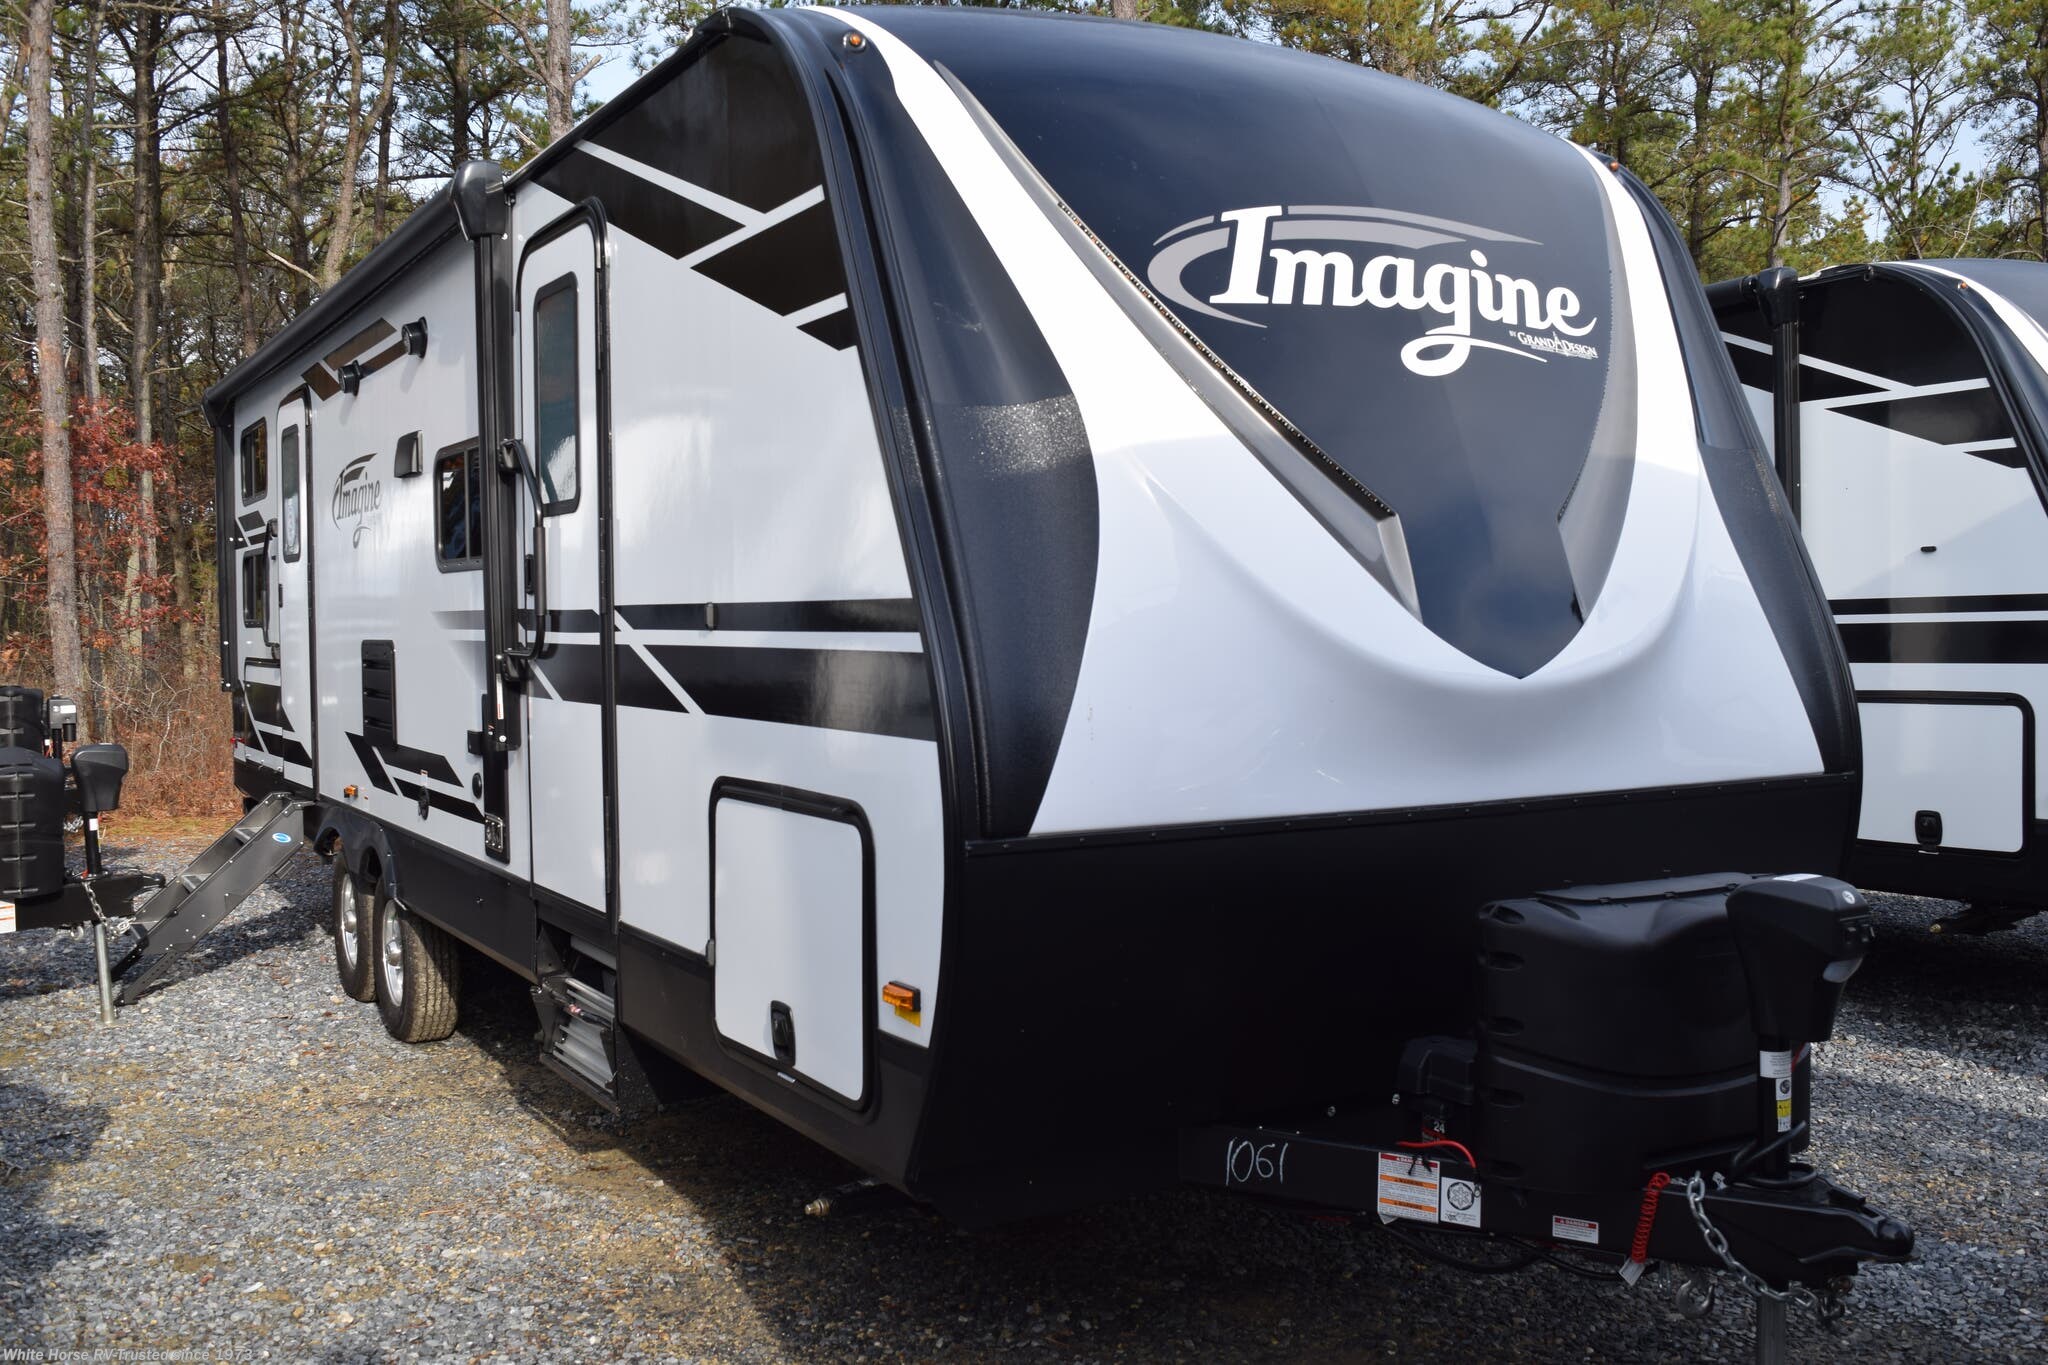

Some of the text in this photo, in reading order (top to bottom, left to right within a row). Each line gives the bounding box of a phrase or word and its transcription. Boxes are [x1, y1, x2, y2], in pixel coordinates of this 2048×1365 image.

[1210, 205, 1598, 377] Imagine
[1517, 331, 1555, 350] GRAND
[1561, 339, 1599, 359] DESIGN
[336, 471, 381, 549] Imagine
[1433, 1120, 1446, 1134] 24
[1225, 1137, 1289, 1187] 1061
